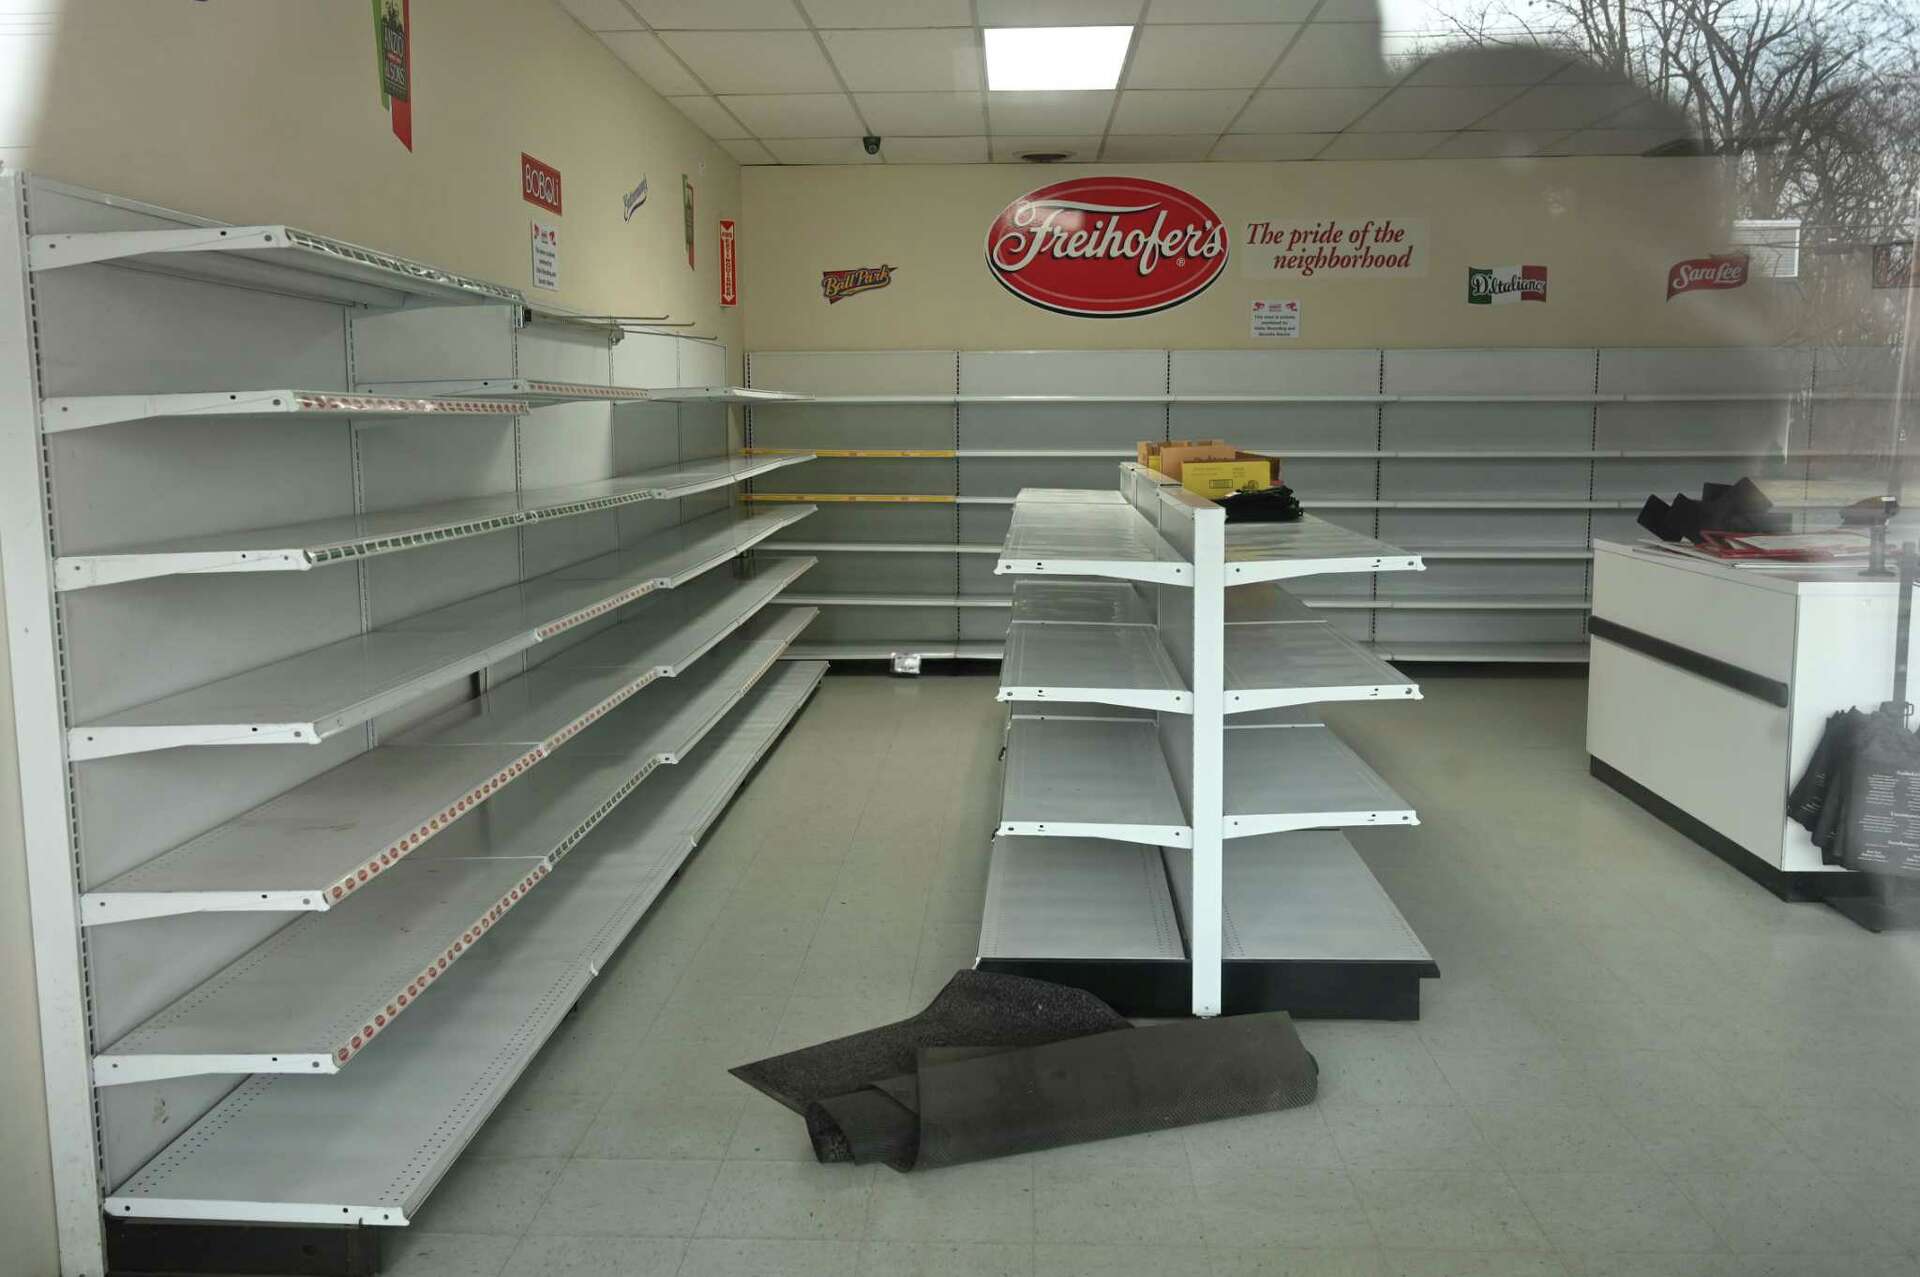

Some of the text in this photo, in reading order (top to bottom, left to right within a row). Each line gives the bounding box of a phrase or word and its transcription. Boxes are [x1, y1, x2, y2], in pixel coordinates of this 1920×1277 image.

[993, 199, 1225, 275] Freihofer's
[1247, 220, 1405, 251] The pride of the
[1274, 245, 1414, 276] neighborhood
[1672, 262, 1743, 289] Sara Lee
[823, 265, 889, 297] Ball Park
